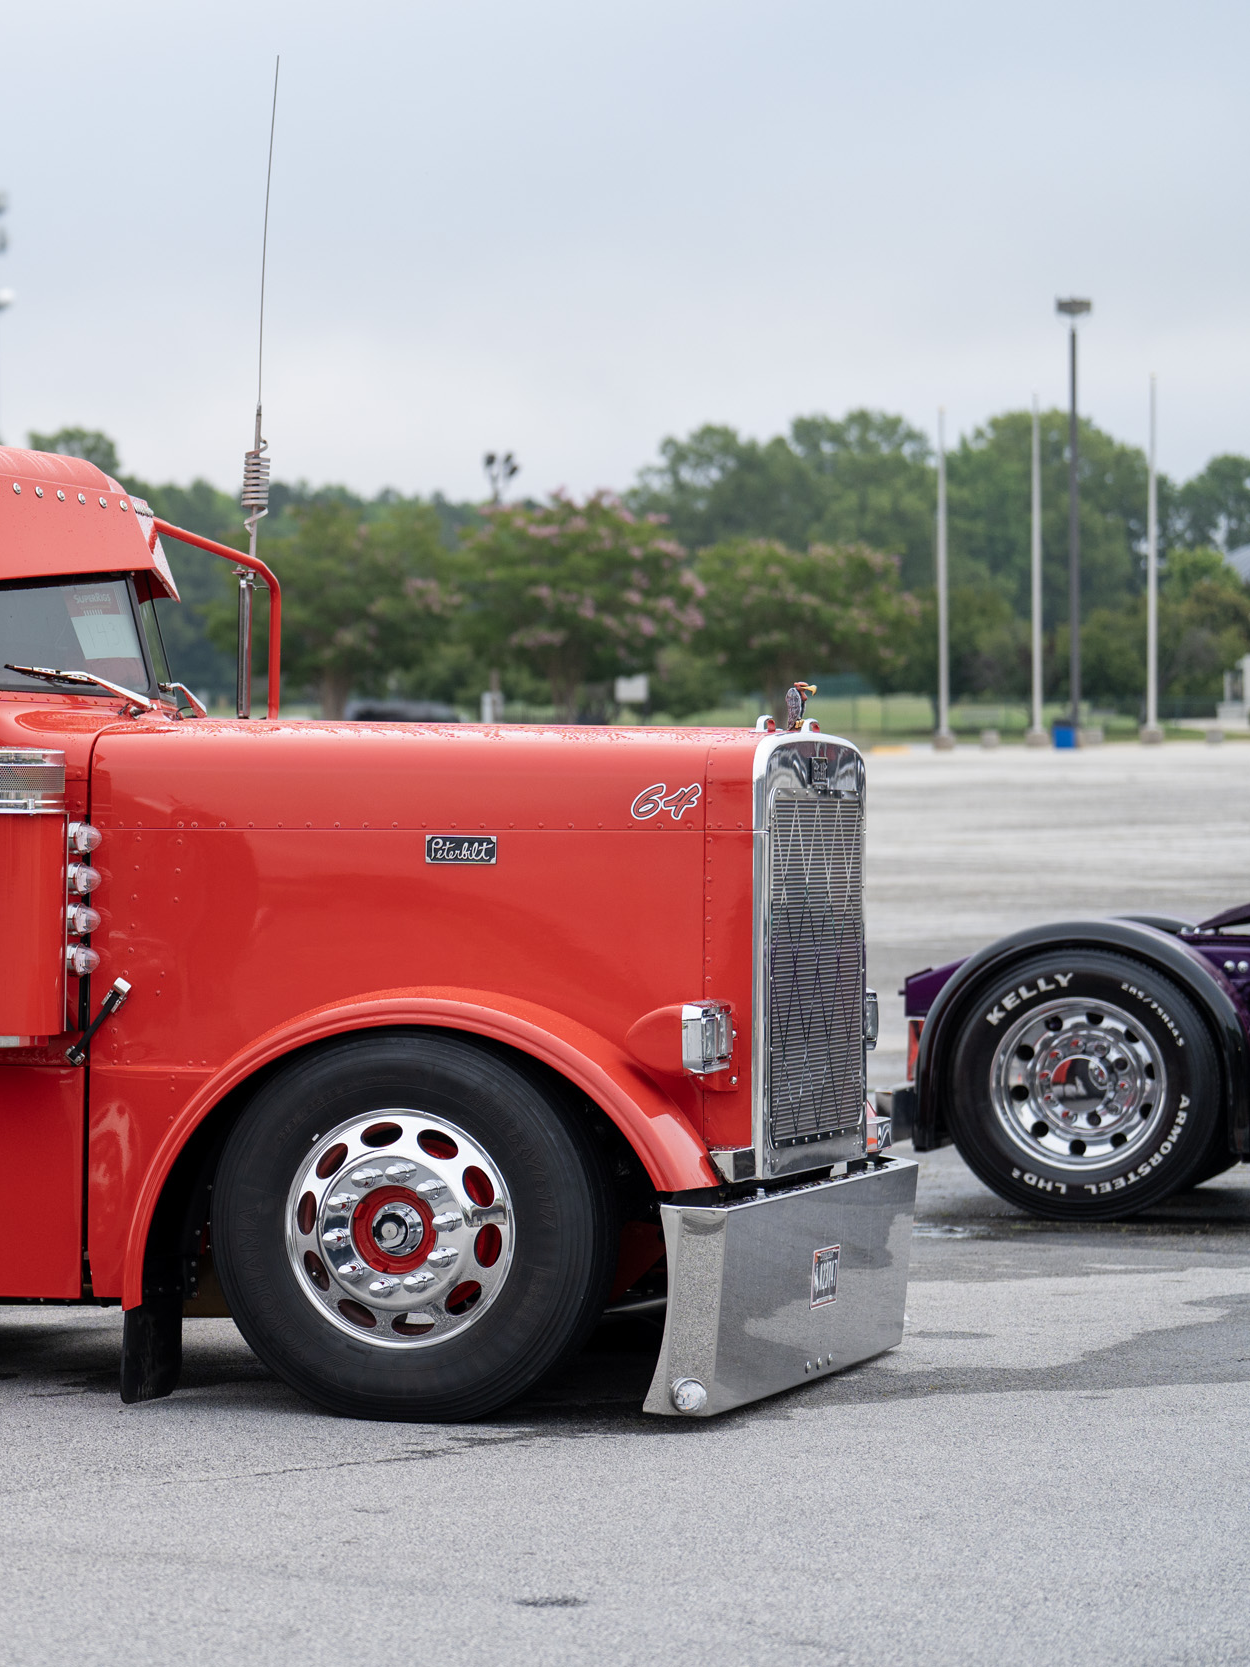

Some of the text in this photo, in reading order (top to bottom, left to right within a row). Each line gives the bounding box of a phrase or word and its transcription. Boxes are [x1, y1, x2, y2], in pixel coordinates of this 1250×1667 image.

[631, 783, 701, 820] 64
[431, 838, 494, 861] Peterbilt
[985, 972, 1073, 1026] KELLY
[1084, 1094, 1191, 1195] ARMORSTEEL
[238, 1206, 312, 1360] YOKOHAMA
